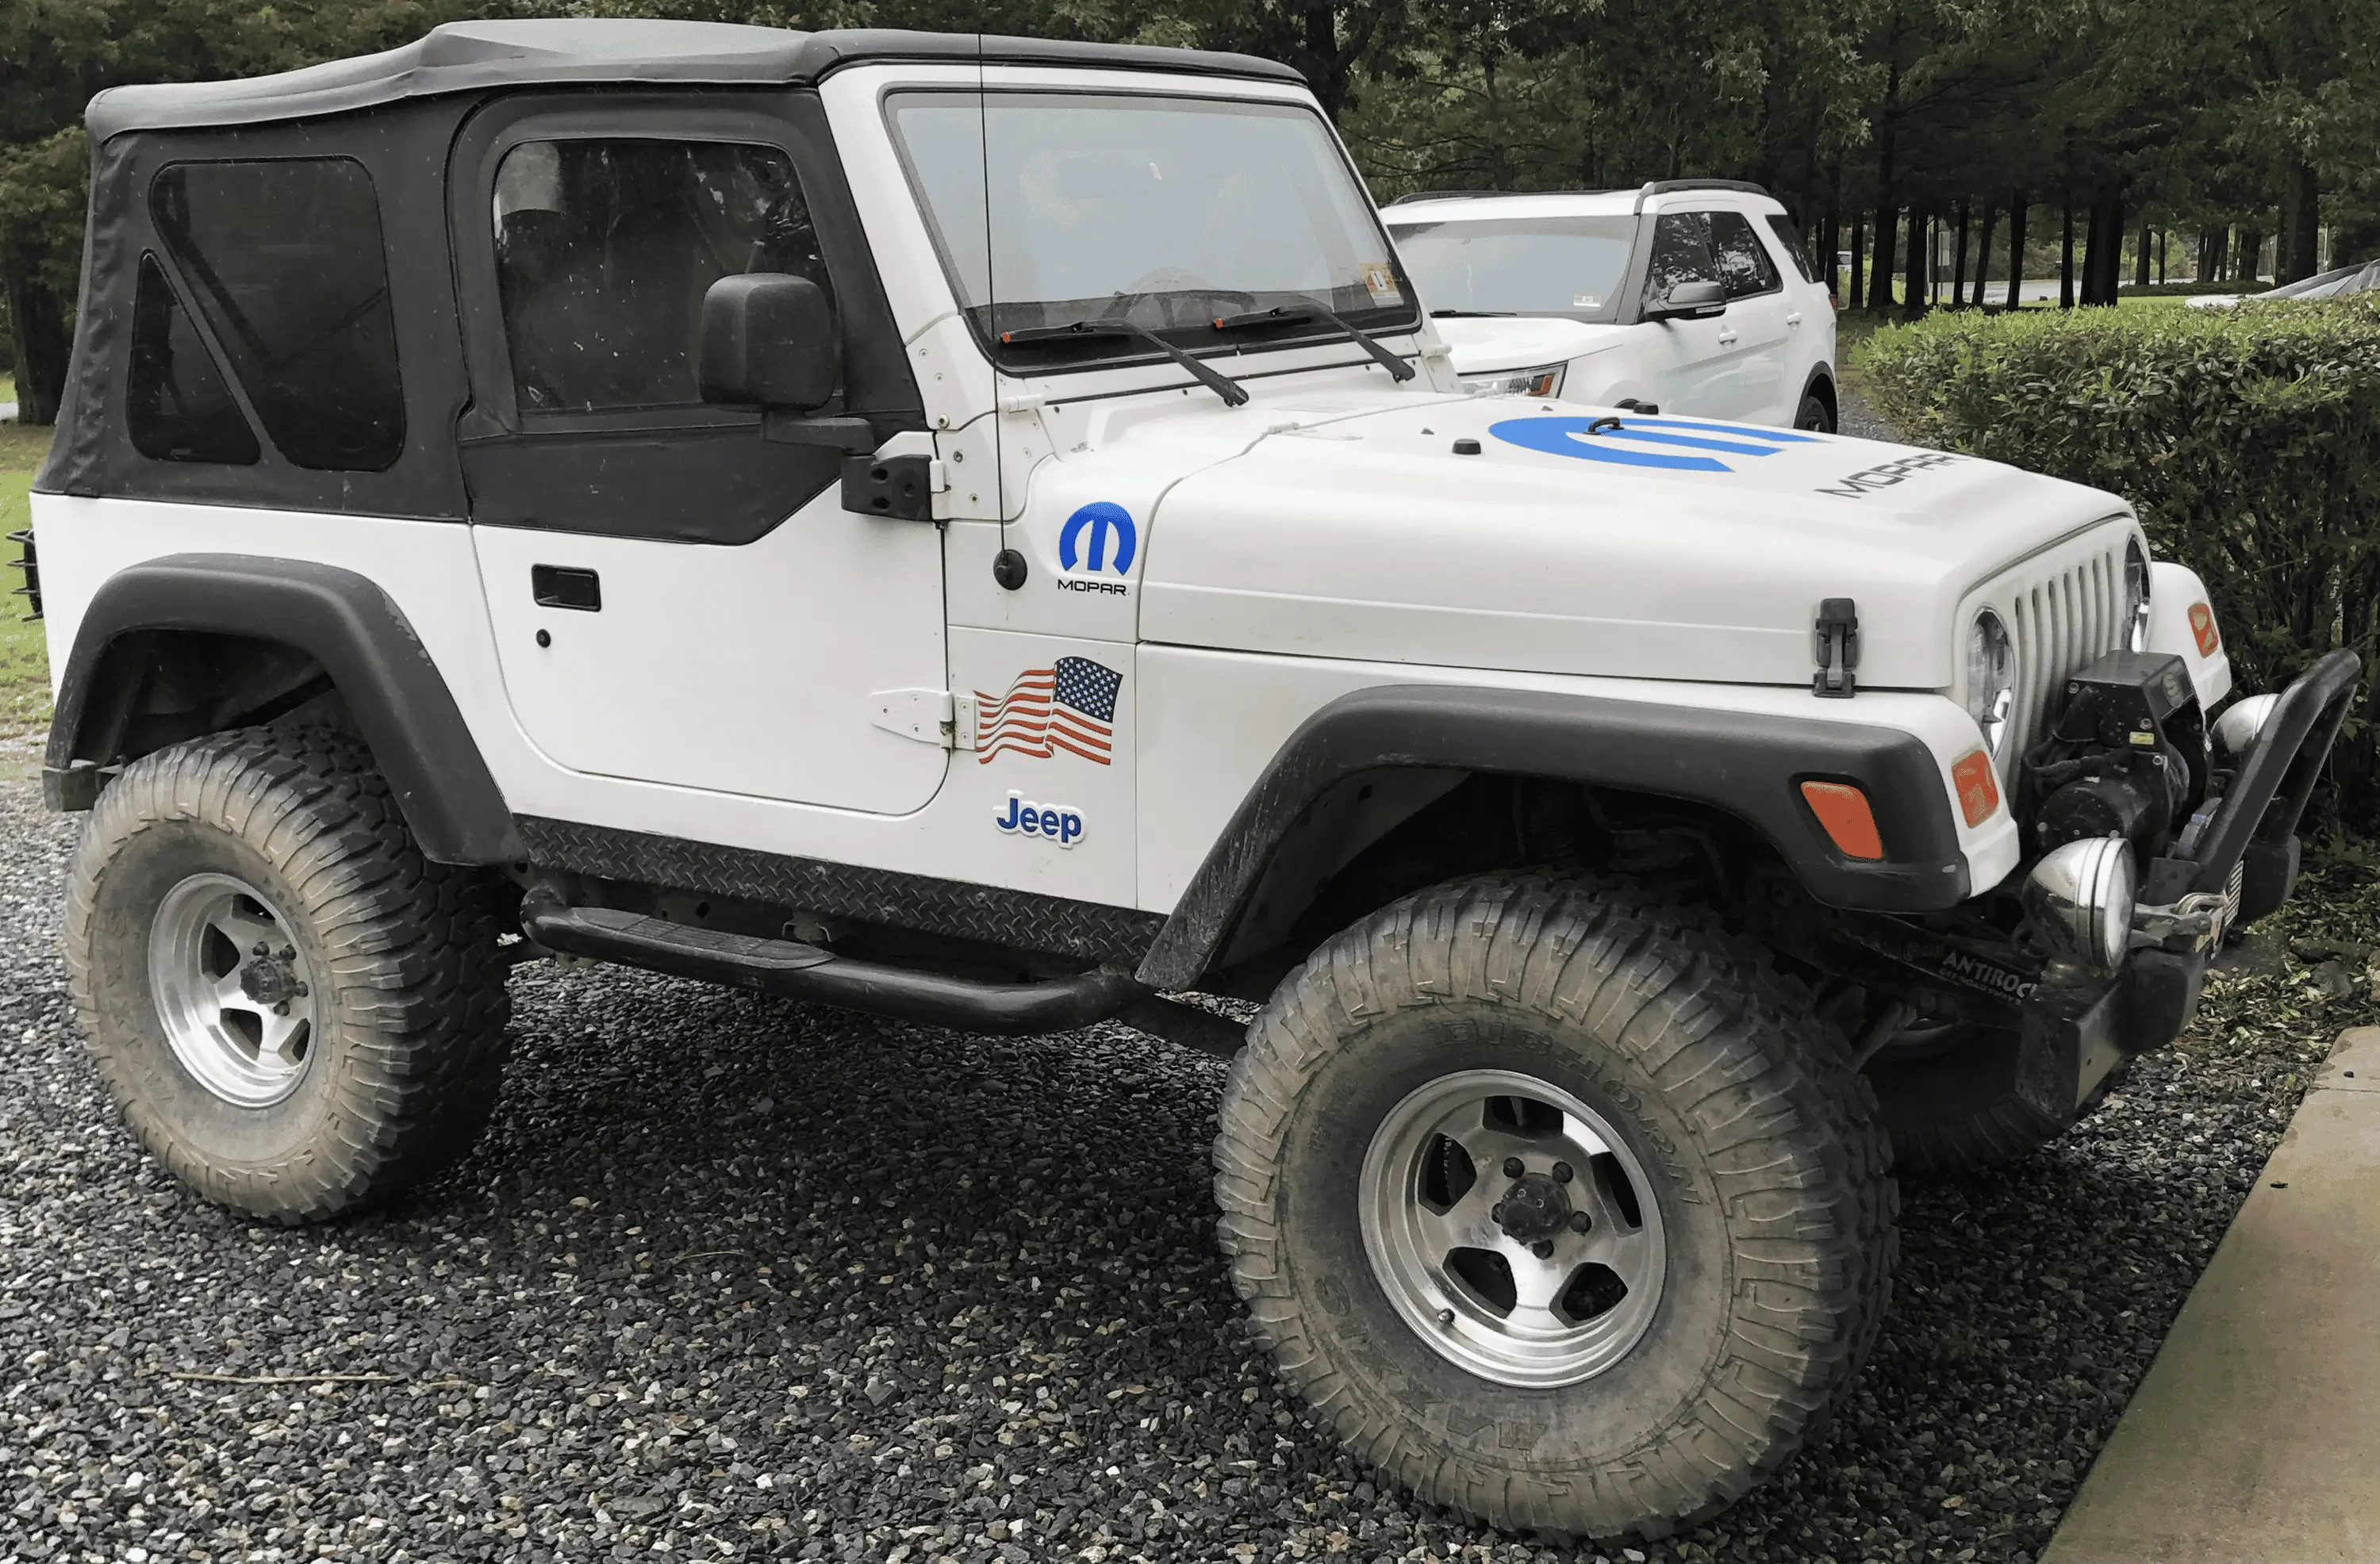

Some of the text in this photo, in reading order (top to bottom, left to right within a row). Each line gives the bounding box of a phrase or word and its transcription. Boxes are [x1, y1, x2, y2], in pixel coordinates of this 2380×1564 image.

[1813, 453, 1971, 499] MOPAR
[1058, 579, 1127, 596] MOPAR
[996, 797, 1082, 843] Jeep
